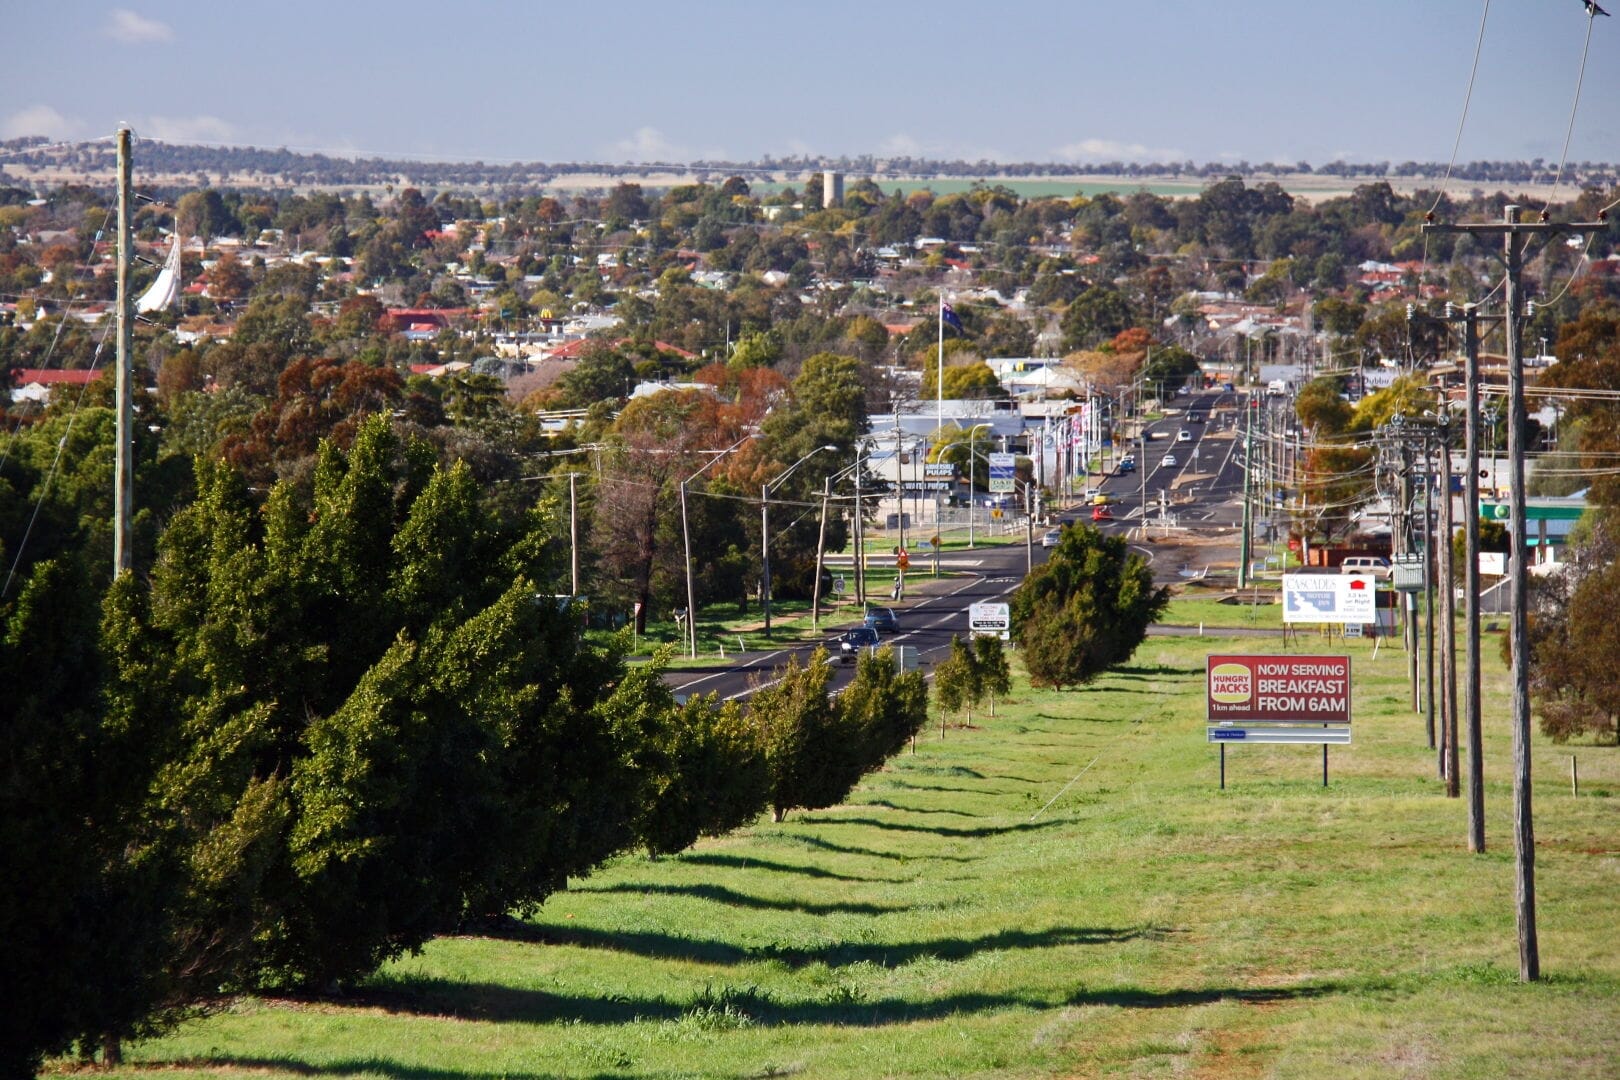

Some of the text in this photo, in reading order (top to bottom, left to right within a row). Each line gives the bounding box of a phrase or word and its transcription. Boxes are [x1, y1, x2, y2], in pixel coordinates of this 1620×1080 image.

[1286, 578, 1336, 590] CASCADES
[1258, 665, 1345, 676] NOW SERVING
[1213, 683, 1249, 693] JACK'S
[1258, 680, 1345, 693] BREAKFAST
[1258, 697, 1345, 712] FROM 6AM
